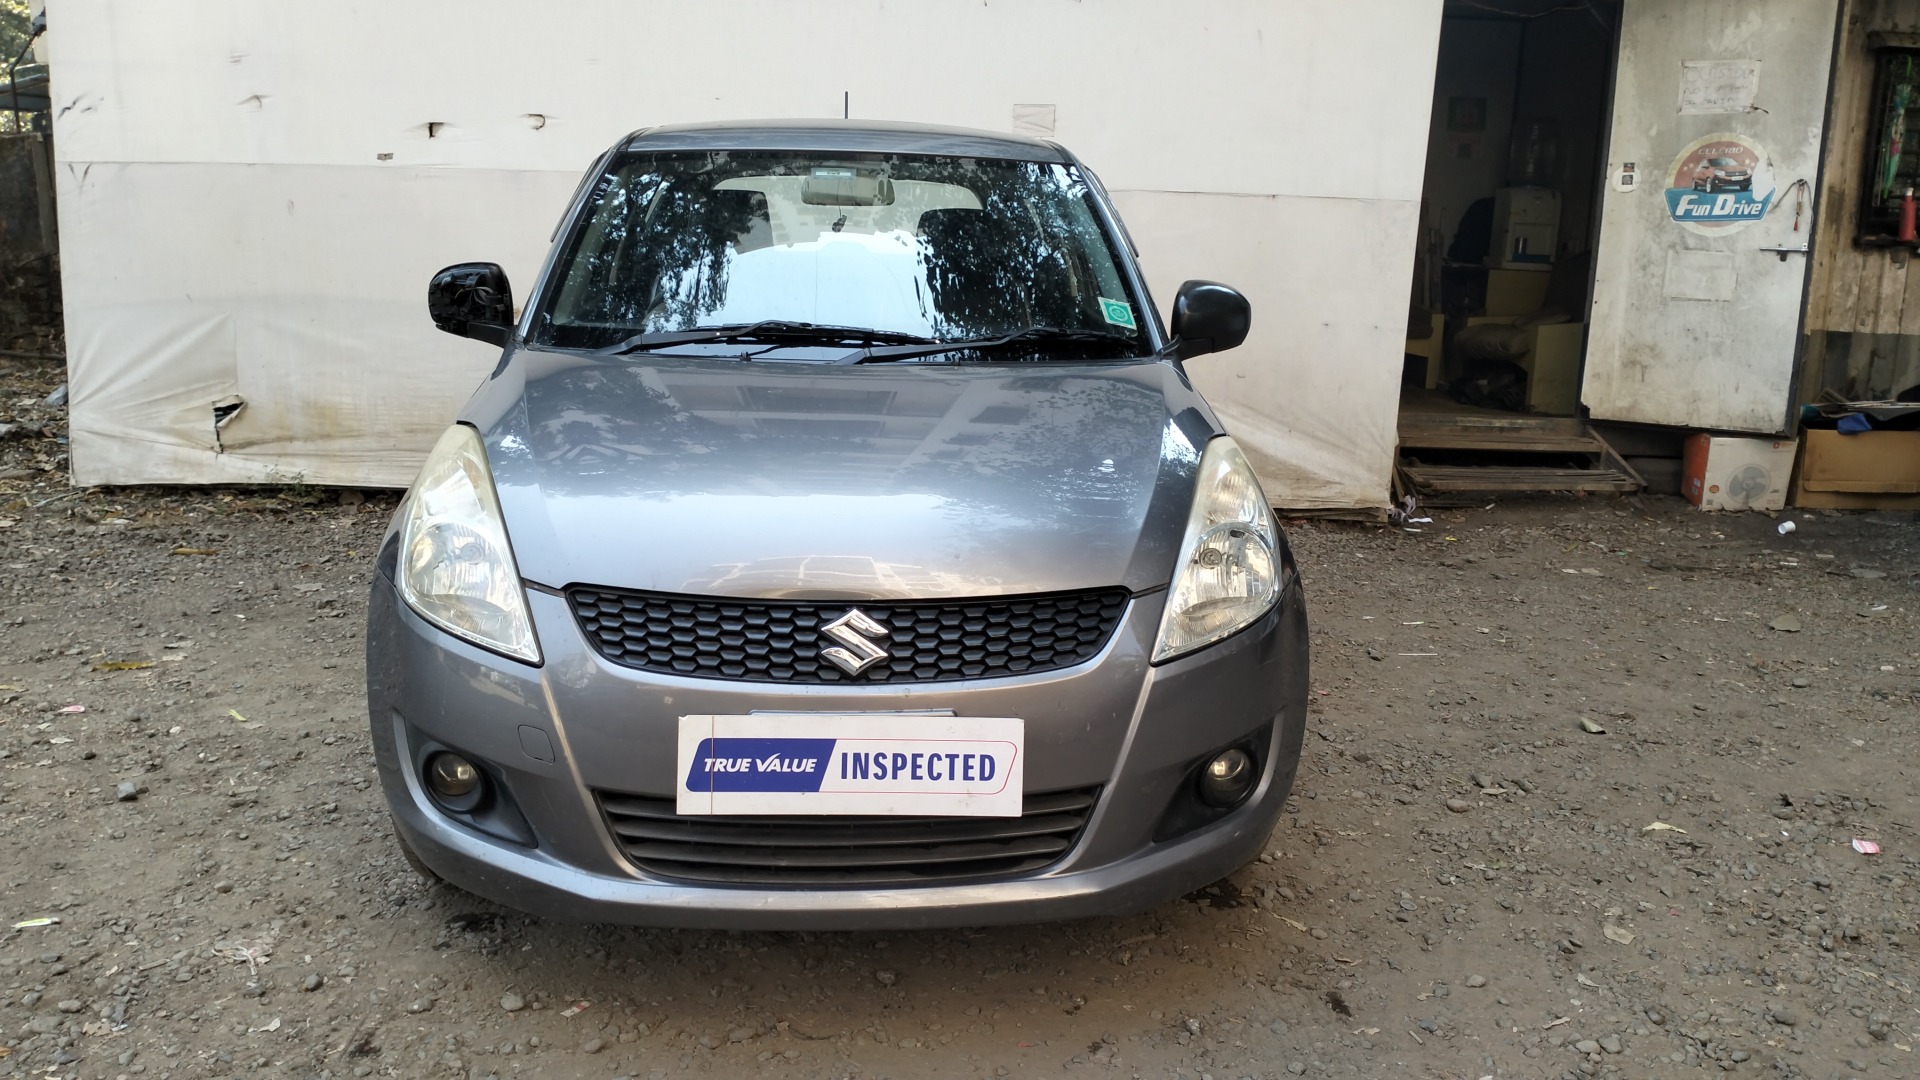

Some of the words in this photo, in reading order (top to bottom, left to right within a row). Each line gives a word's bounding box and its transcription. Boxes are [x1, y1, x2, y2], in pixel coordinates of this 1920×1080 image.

[1675, 194, 1711, 216] Fun
[1711, 194, 1762, 216] Drive
[703, 758, 751, 773] TRUE
[755, 752, 818, 773] VALUE
[840, 751, 996, 782] INSPECTED
